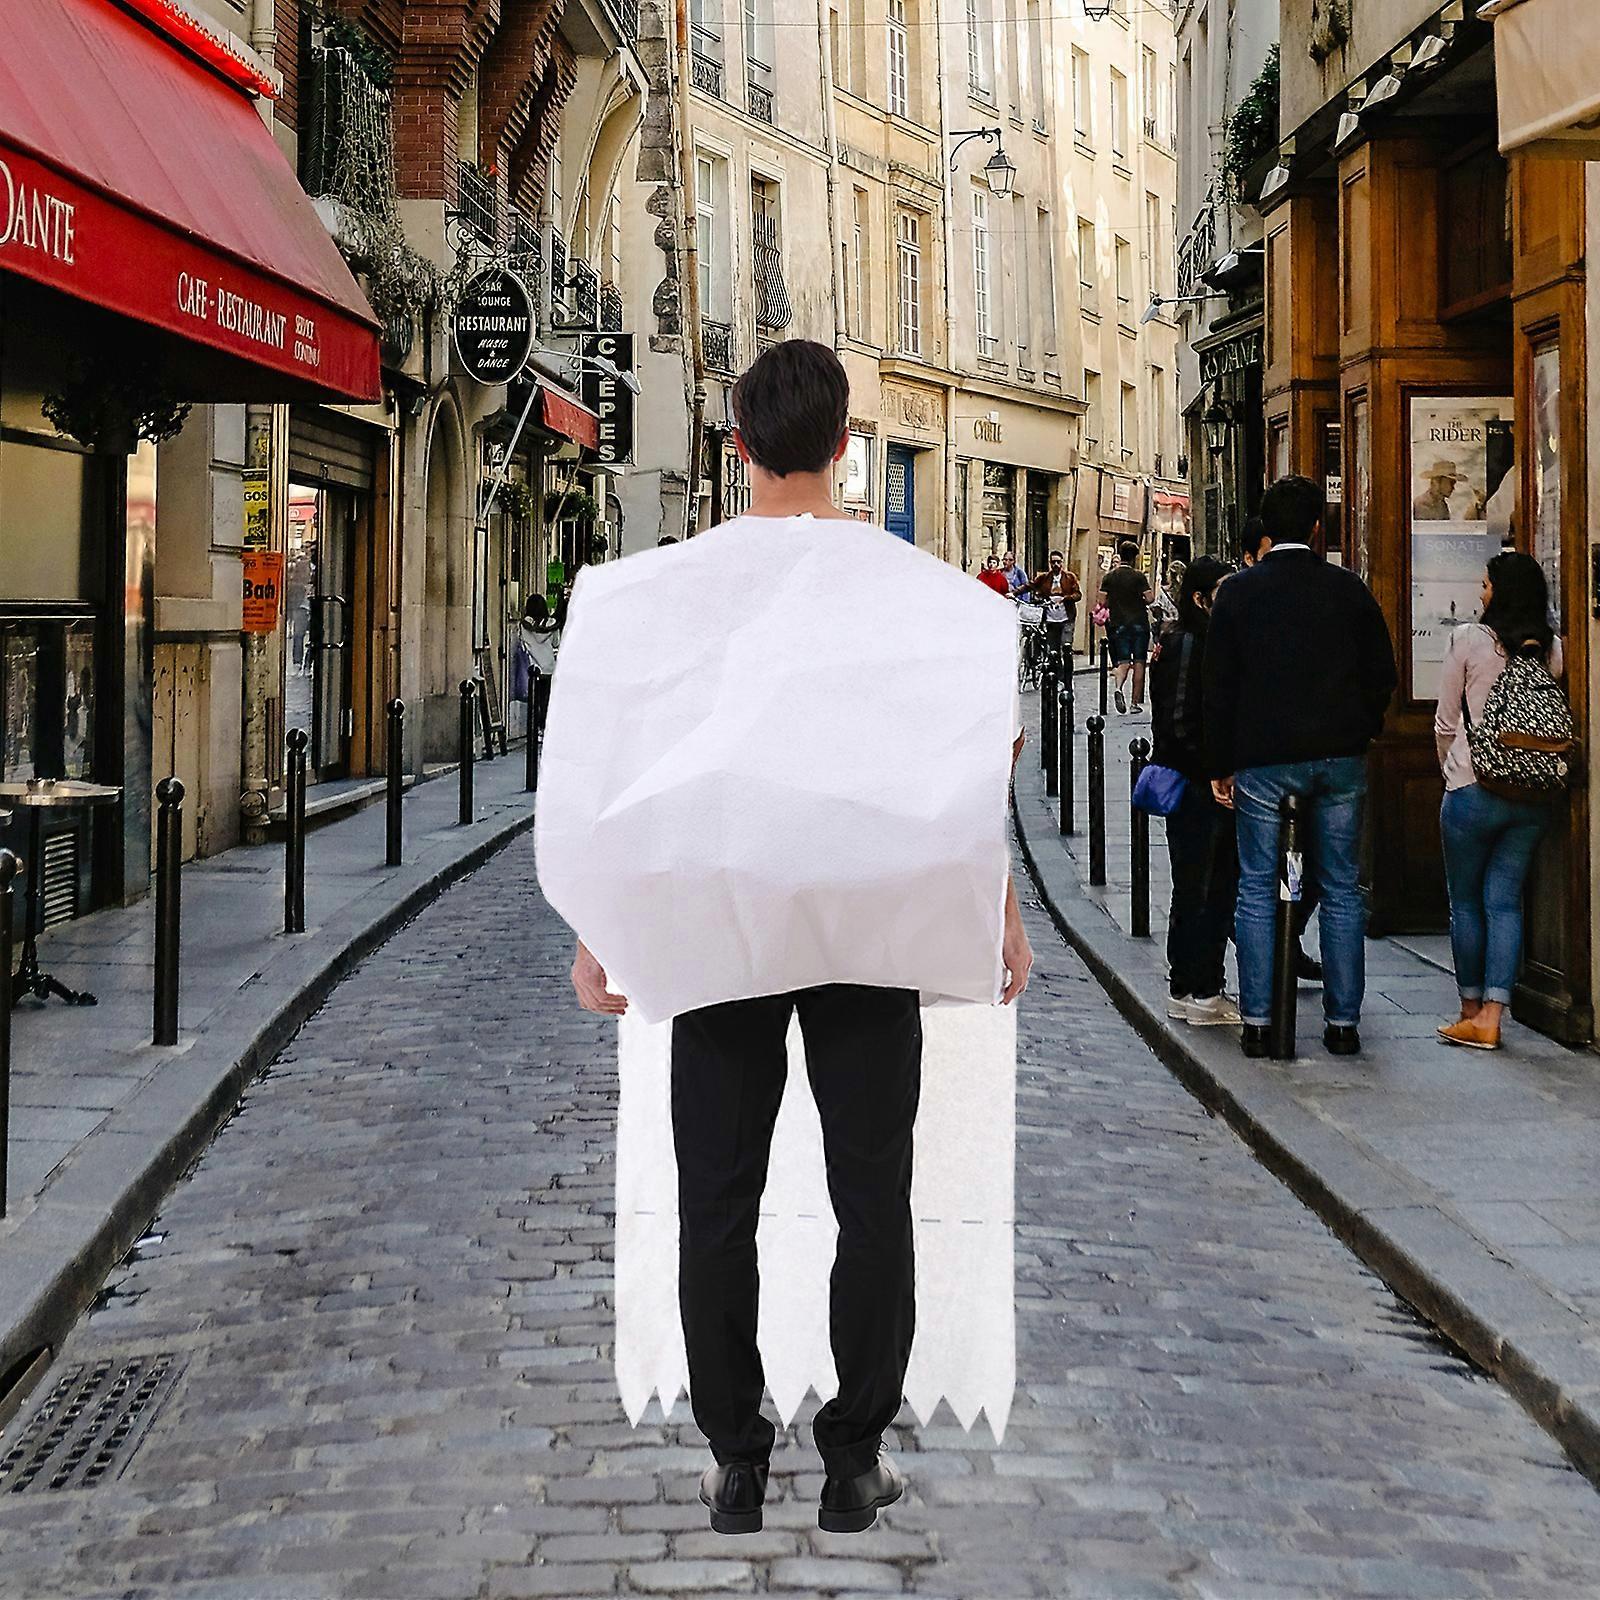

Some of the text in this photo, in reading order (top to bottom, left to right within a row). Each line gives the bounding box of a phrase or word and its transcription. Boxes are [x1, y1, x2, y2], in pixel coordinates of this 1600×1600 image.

[478, 296, 511, 307] LOUNGE
[178, 271, 208, 320] CAFE
[217, 288, 286, 350] RESTAURANT
[459, 315, 527, 332] RESTAURANT
[477, 339, 509, 349] MUSIC
[477, 358, 510, 368] DANCE
[597, 338, 618, 462] CÊPES
[1430, 428, 1482, 442] RIDER
[1424, 539, 1487, 552] SONATE
